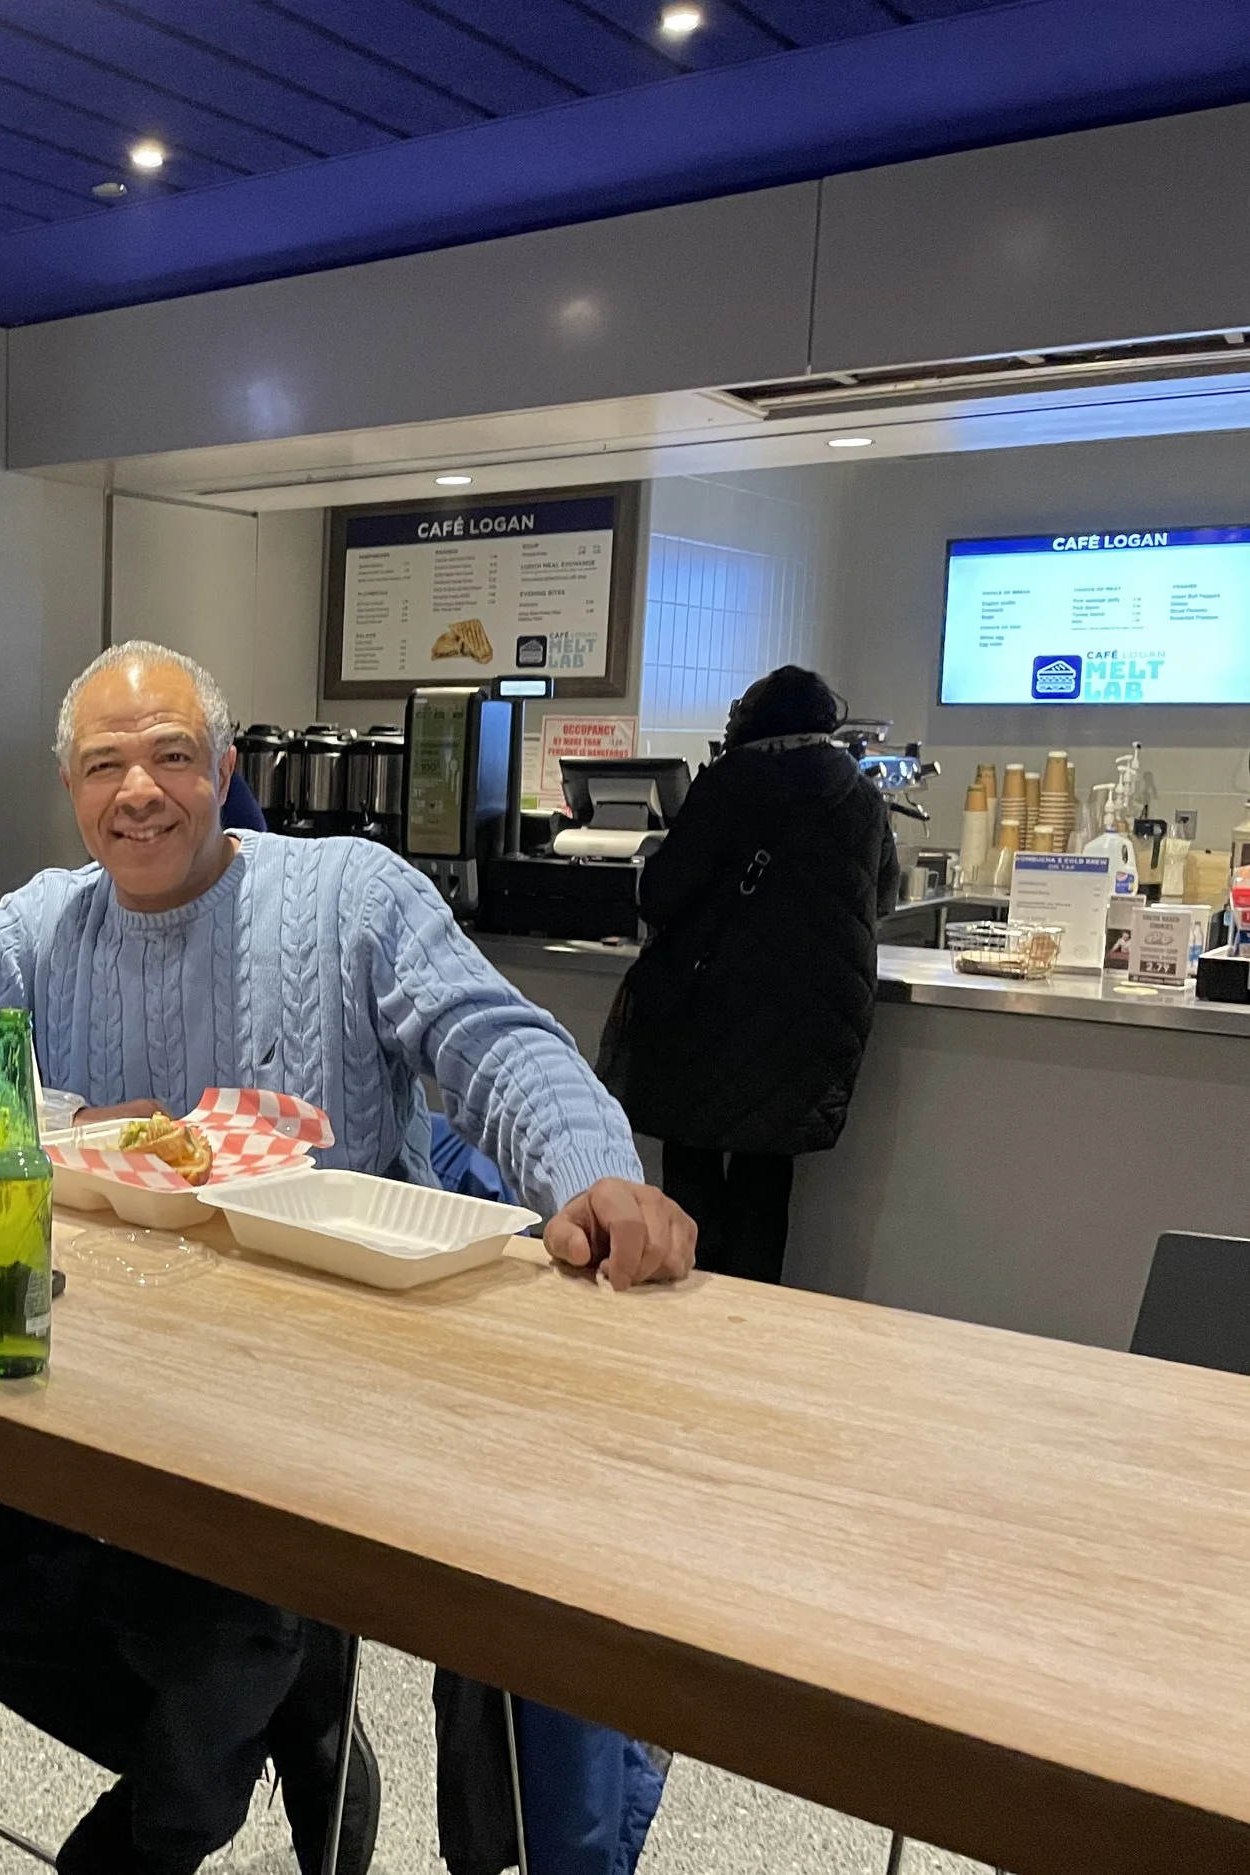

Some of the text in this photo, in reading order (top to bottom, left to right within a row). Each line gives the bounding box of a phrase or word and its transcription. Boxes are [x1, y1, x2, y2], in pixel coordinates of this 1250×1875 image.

[417, 513, 535, 538] CAFÉ LOGAN
[1052, 532, 1168, 551] CAFÉ LOGAN
[549, 638, 597, 653] MELT
[548, 654, 584, 668] LAB
[1086, 650, 1167, 660] CAFÉ LOGAN
[1085, 660, 1165, 680] MELT
[1083, 681, 1144, 701] LAB
[563, 724, 616, 736] OCCUPANCY
